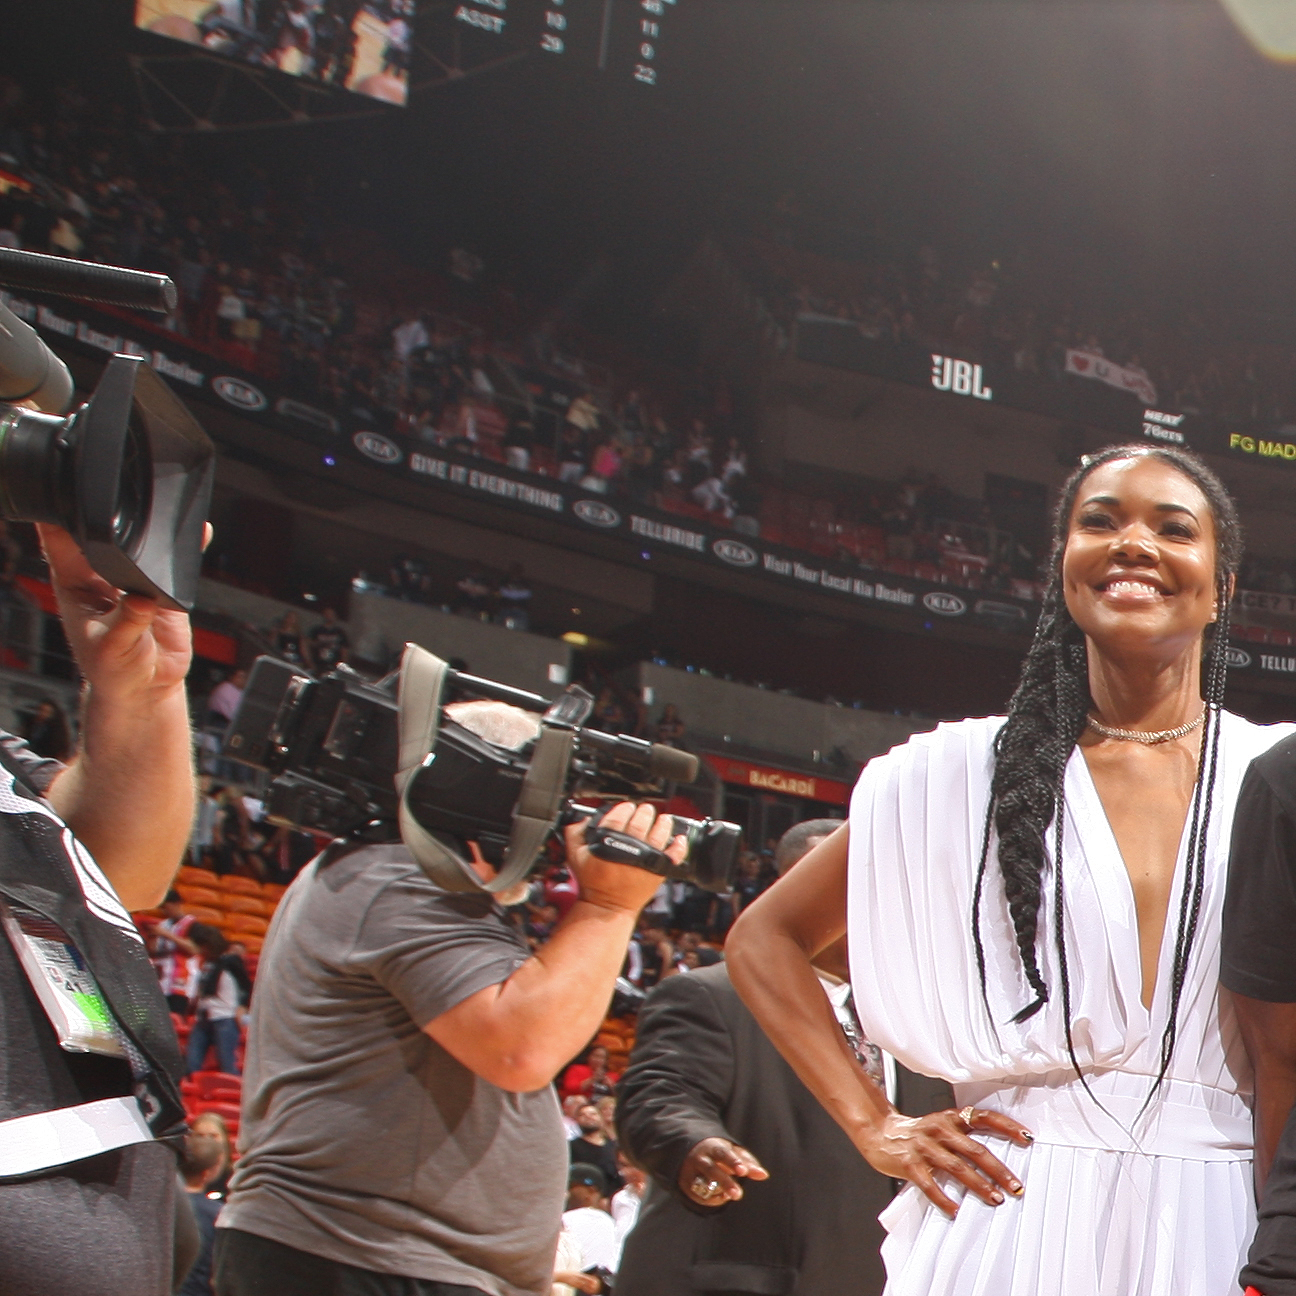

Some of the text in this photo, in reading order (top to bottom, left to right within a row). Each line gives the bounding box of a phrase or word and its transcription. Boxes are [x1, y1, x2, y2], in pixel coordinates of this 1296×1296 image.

[455, 6, 505, 33] ASST
[932, 354, 992, 400] JBL
[1144, 409, 1185, 427] HEAT
[1143, 422, 1184, 443] 76ers
[1229, 433, 1254, 453] FG
[411, 453, 563, 511] GIVE IT EVERYTHING
[763, 552, 914, 605] Visit Your Local Kia Dealer
[604, 836, 641, 856] Canon
